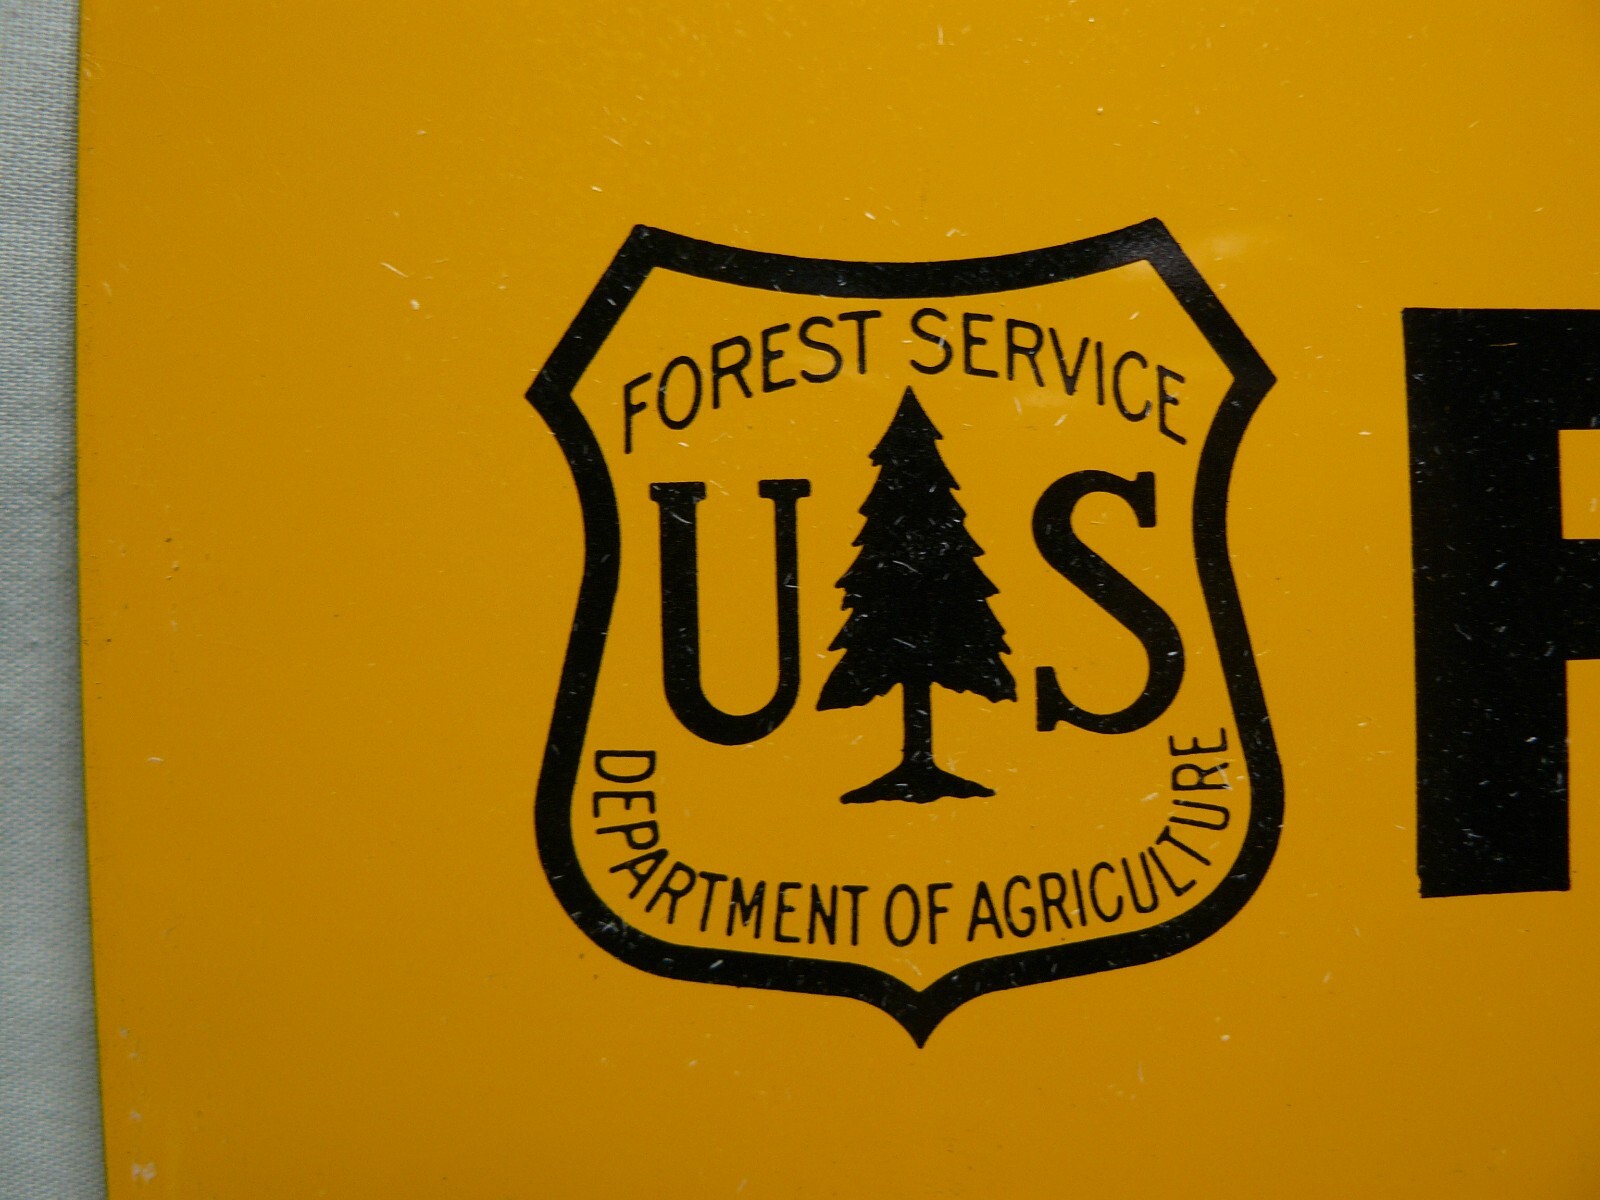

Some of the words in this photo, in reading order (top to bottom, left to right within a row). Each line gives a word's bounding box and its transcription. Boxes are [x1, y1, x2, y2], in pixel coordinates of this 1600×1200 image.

[622, 309, 882, 455] FOREST
[910, 307, 1188, 445] SERVICE
[649, 478, 811, 747] U
[1031, 469, 1186, 735] S
[592, 749, 869, 946] DEPARTMENT
[884, 882, 953, 948] OF
[967, 727, 1230, 942] AGRICULTURE
